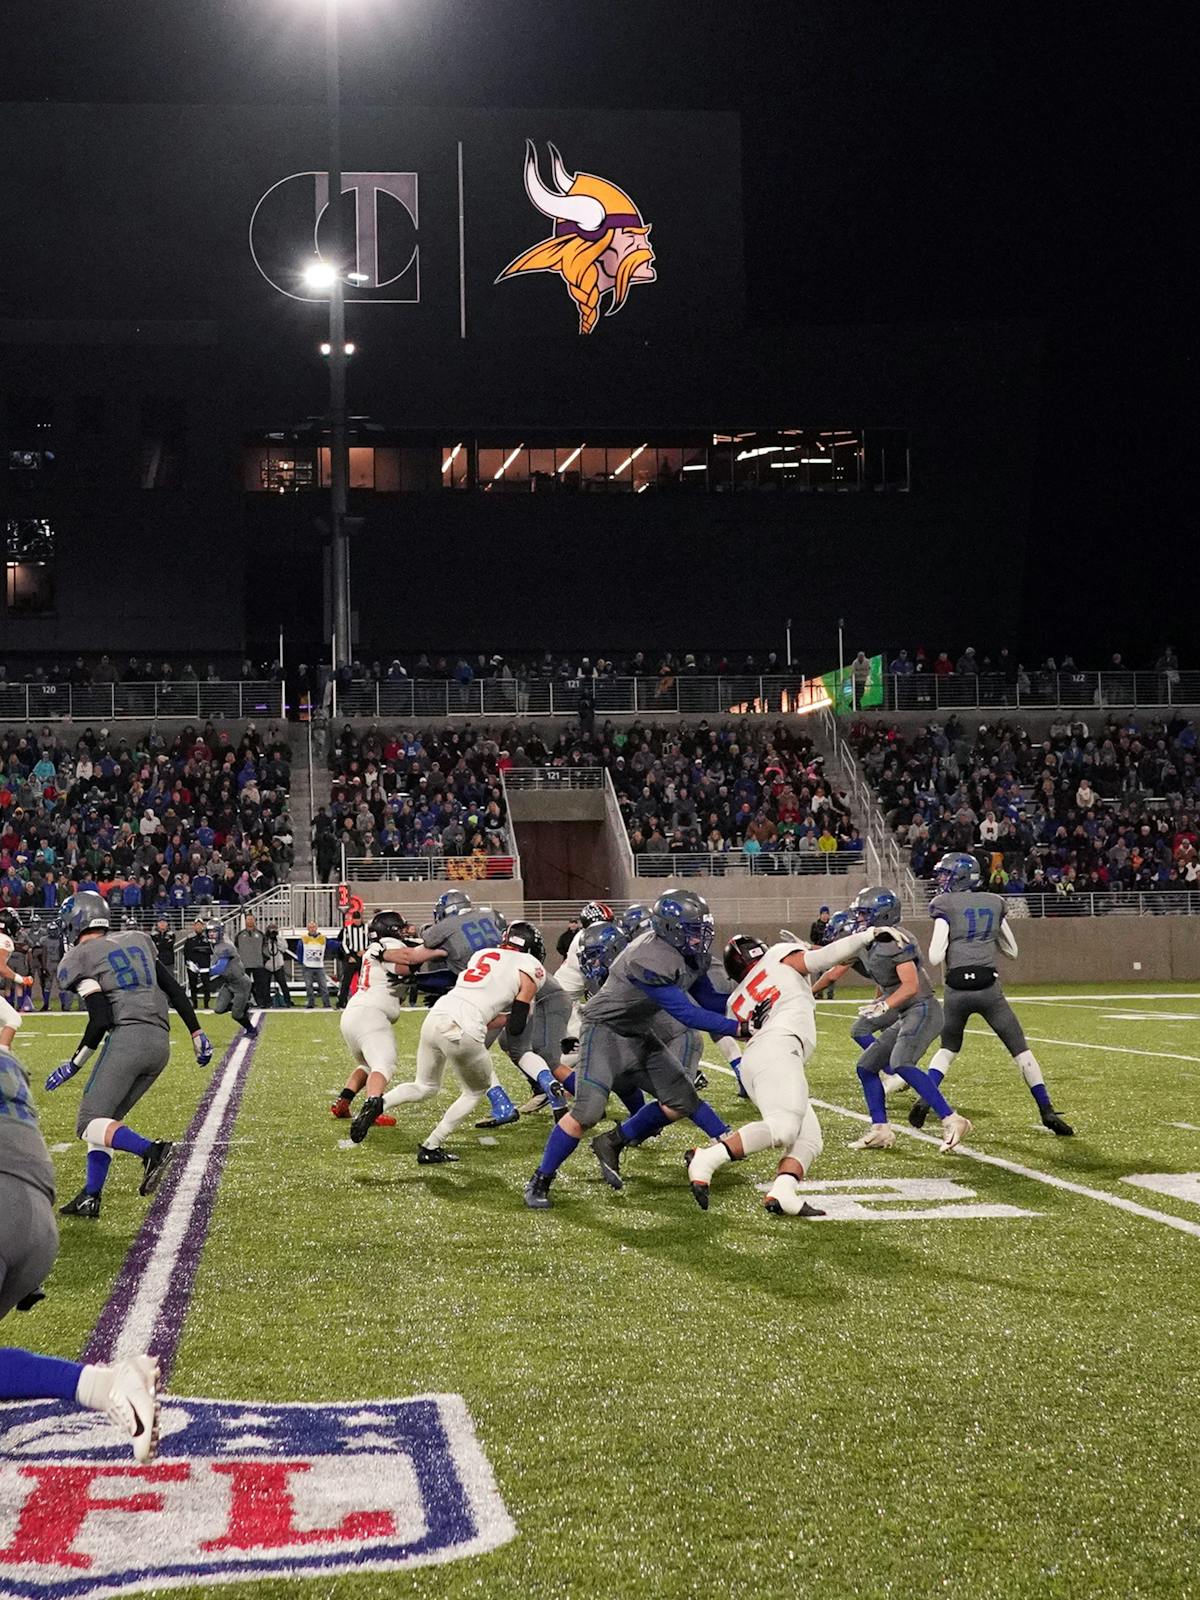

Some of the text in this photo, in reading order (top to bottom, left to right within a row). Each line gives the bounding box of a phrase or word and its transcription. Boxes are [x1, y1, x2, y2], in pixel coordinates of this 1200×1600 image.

[42, 686, 56, 694] 120
[546, 771, 560, 780] 121
[338, 886, 349, 906] 3
[963, 907, 994, 943] 17
[108, 945, 153, 990] 87
[463, 951, 501, 983] 5
